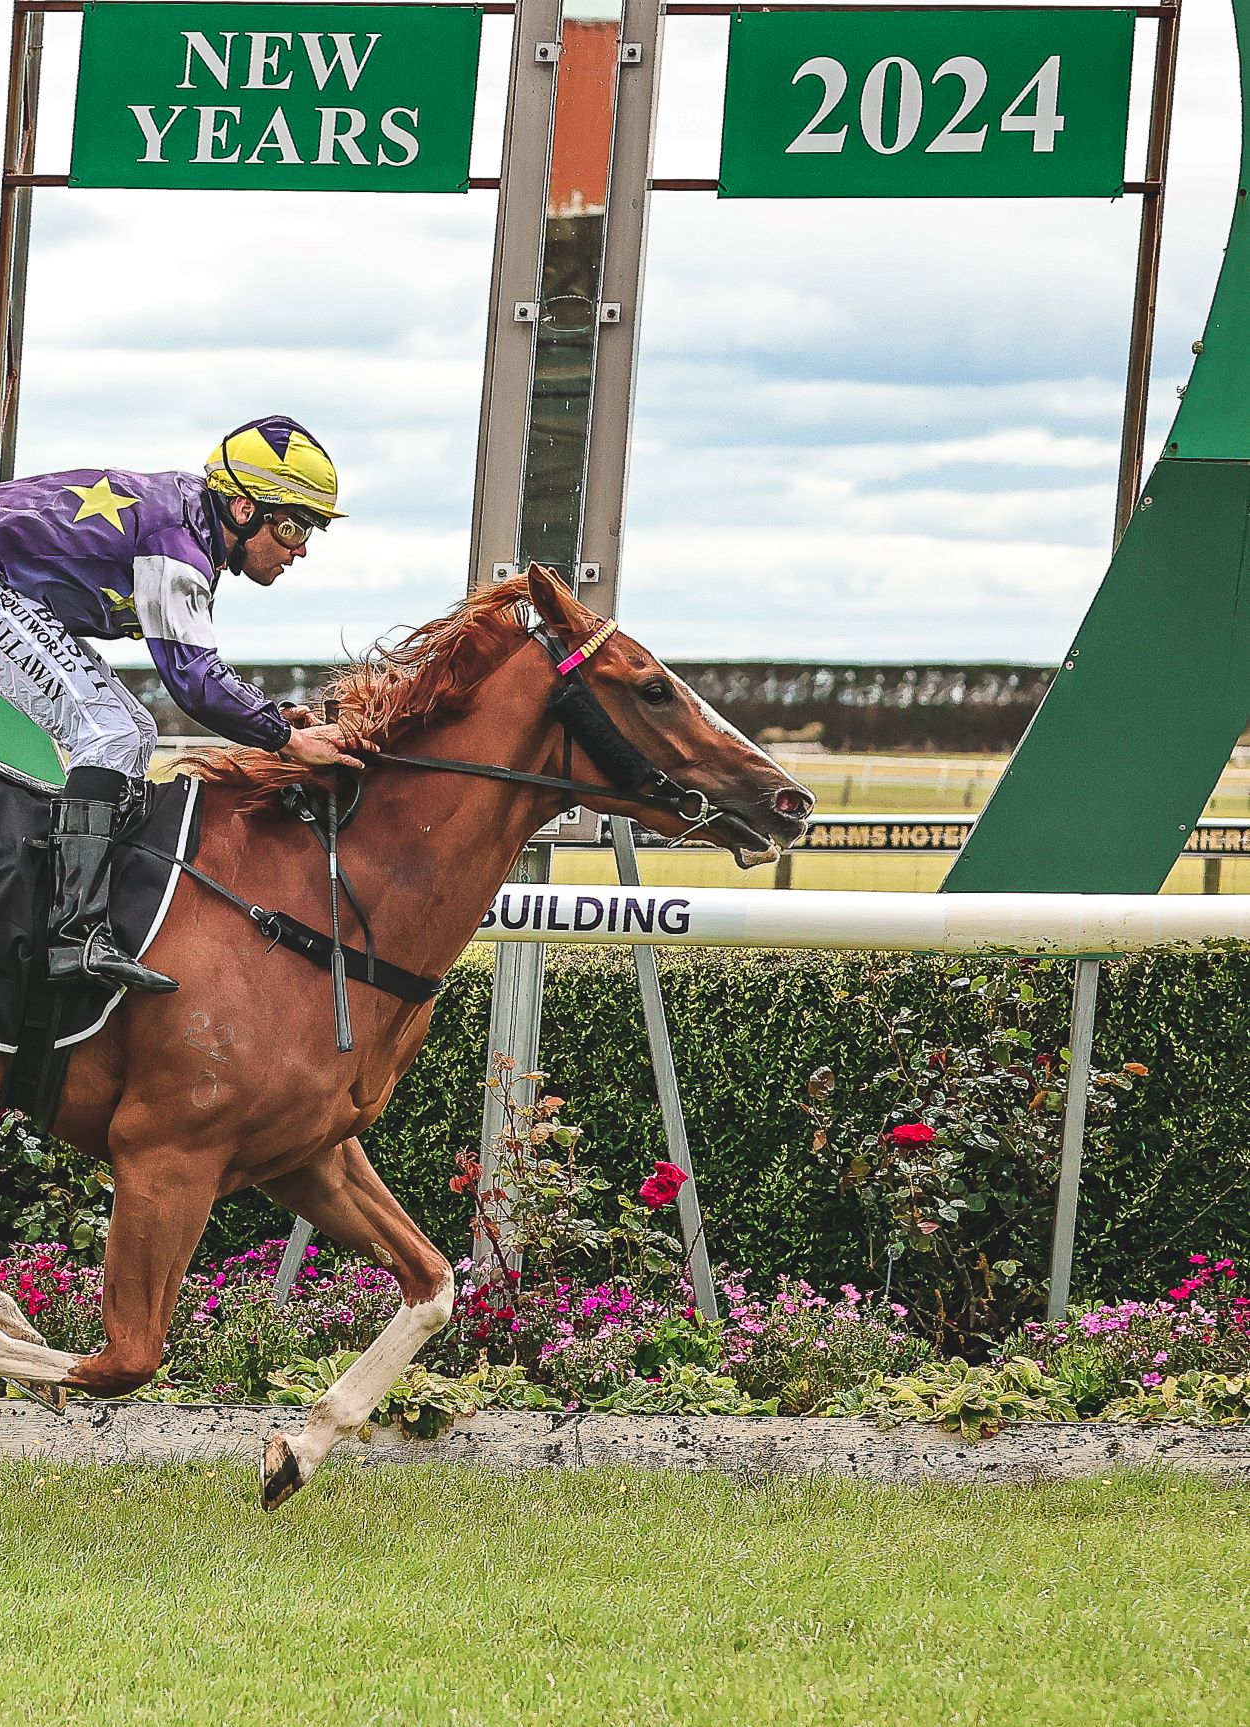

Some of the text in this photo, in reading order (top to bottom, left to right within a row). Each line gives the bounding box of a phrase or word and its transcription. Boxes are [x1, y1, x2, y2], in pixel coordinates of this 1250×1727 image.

[175, 31, 382, 92] NEW
[785, 55, 1065, 155] 2024
[127, 105, 421, 167] YEARS
[810, 825, 887, 848] ARMS
